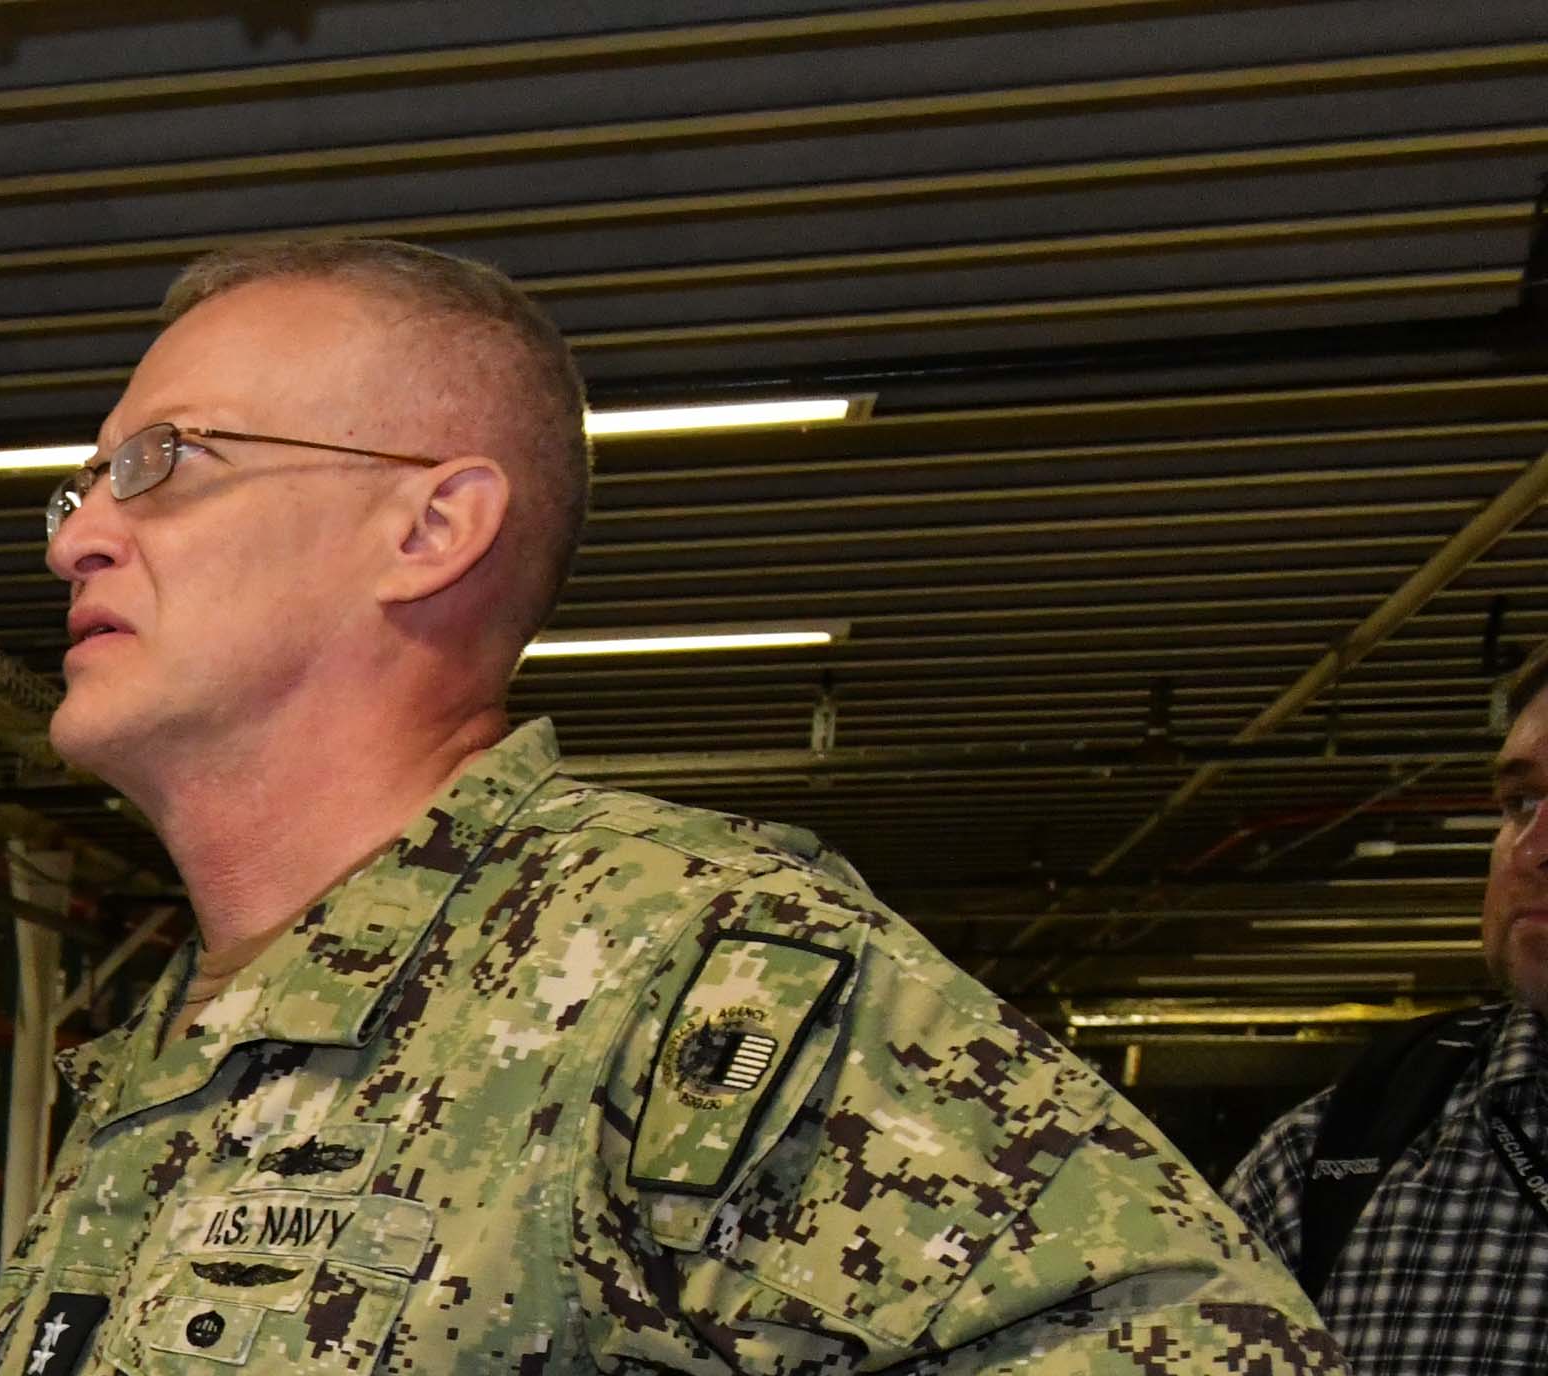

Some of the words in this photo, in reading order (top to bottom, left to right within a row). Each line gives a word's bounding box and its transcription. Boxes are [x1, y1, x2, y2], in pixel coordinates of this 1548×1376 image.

[719, 1006, 769, 1022] AGENCY
[1491, 1116, 1534, 1177] SPECIAL
[203, 1205, 250, 1246] U.S.
[258, 1205, 356, 1249] NAVY
